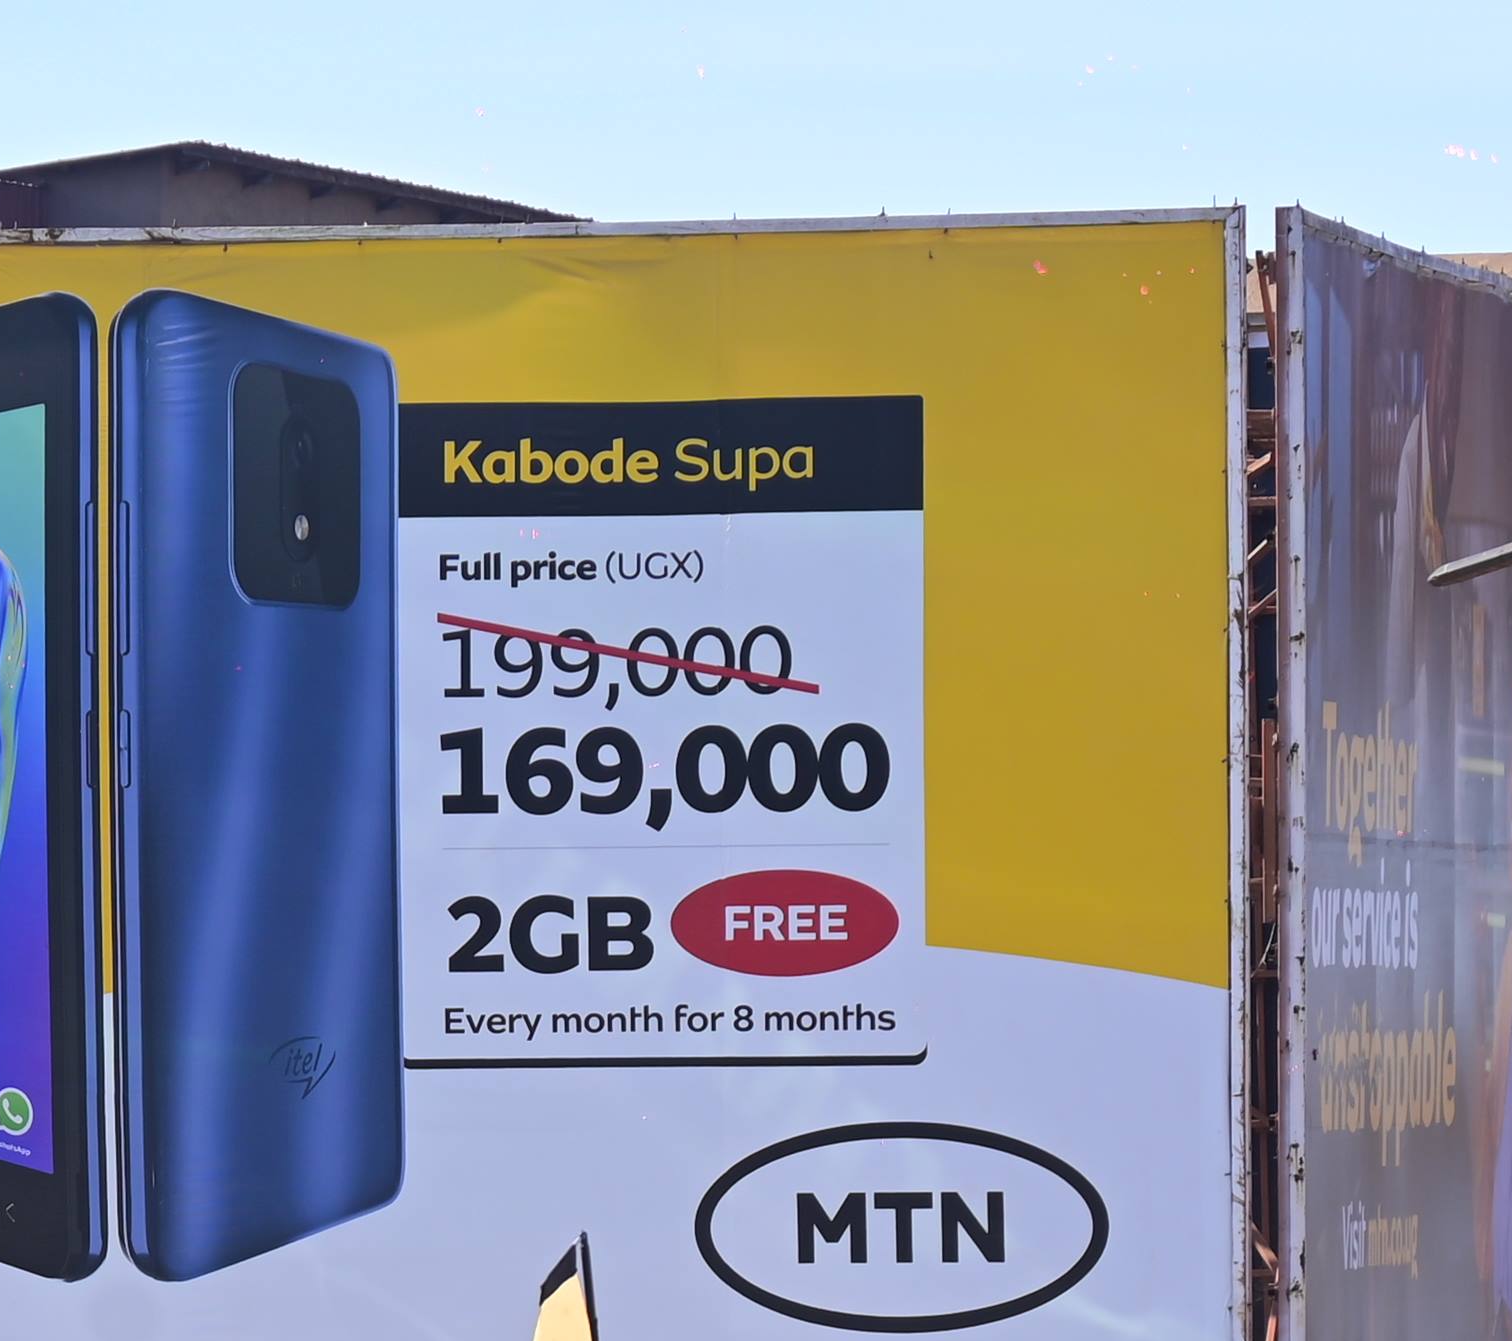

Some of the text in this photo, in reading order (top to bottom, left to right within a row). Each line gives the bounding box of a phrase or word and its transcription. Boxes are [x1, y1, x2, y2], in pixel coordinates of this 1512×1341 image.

[443, 438, 814, 491] Kabode Supa
[438, 550, 704, 587] Full price (UGX)
[440, 624, 793, 710] 199,000
[440, 722, 890, 831] 169,000
[1322, 700, 1418, 868] Together
[448, 895, 848, 974] 2GB FREE
[1312, 858, 1400, 969] our service
[444, 1005, 896, 1041] Every month for 8 months
[1319, 990, 1456, 1167] unstoppable
[796, 1191, 1006, 1264] MTN
[1342, 1200, 1365, 1271] Visit
